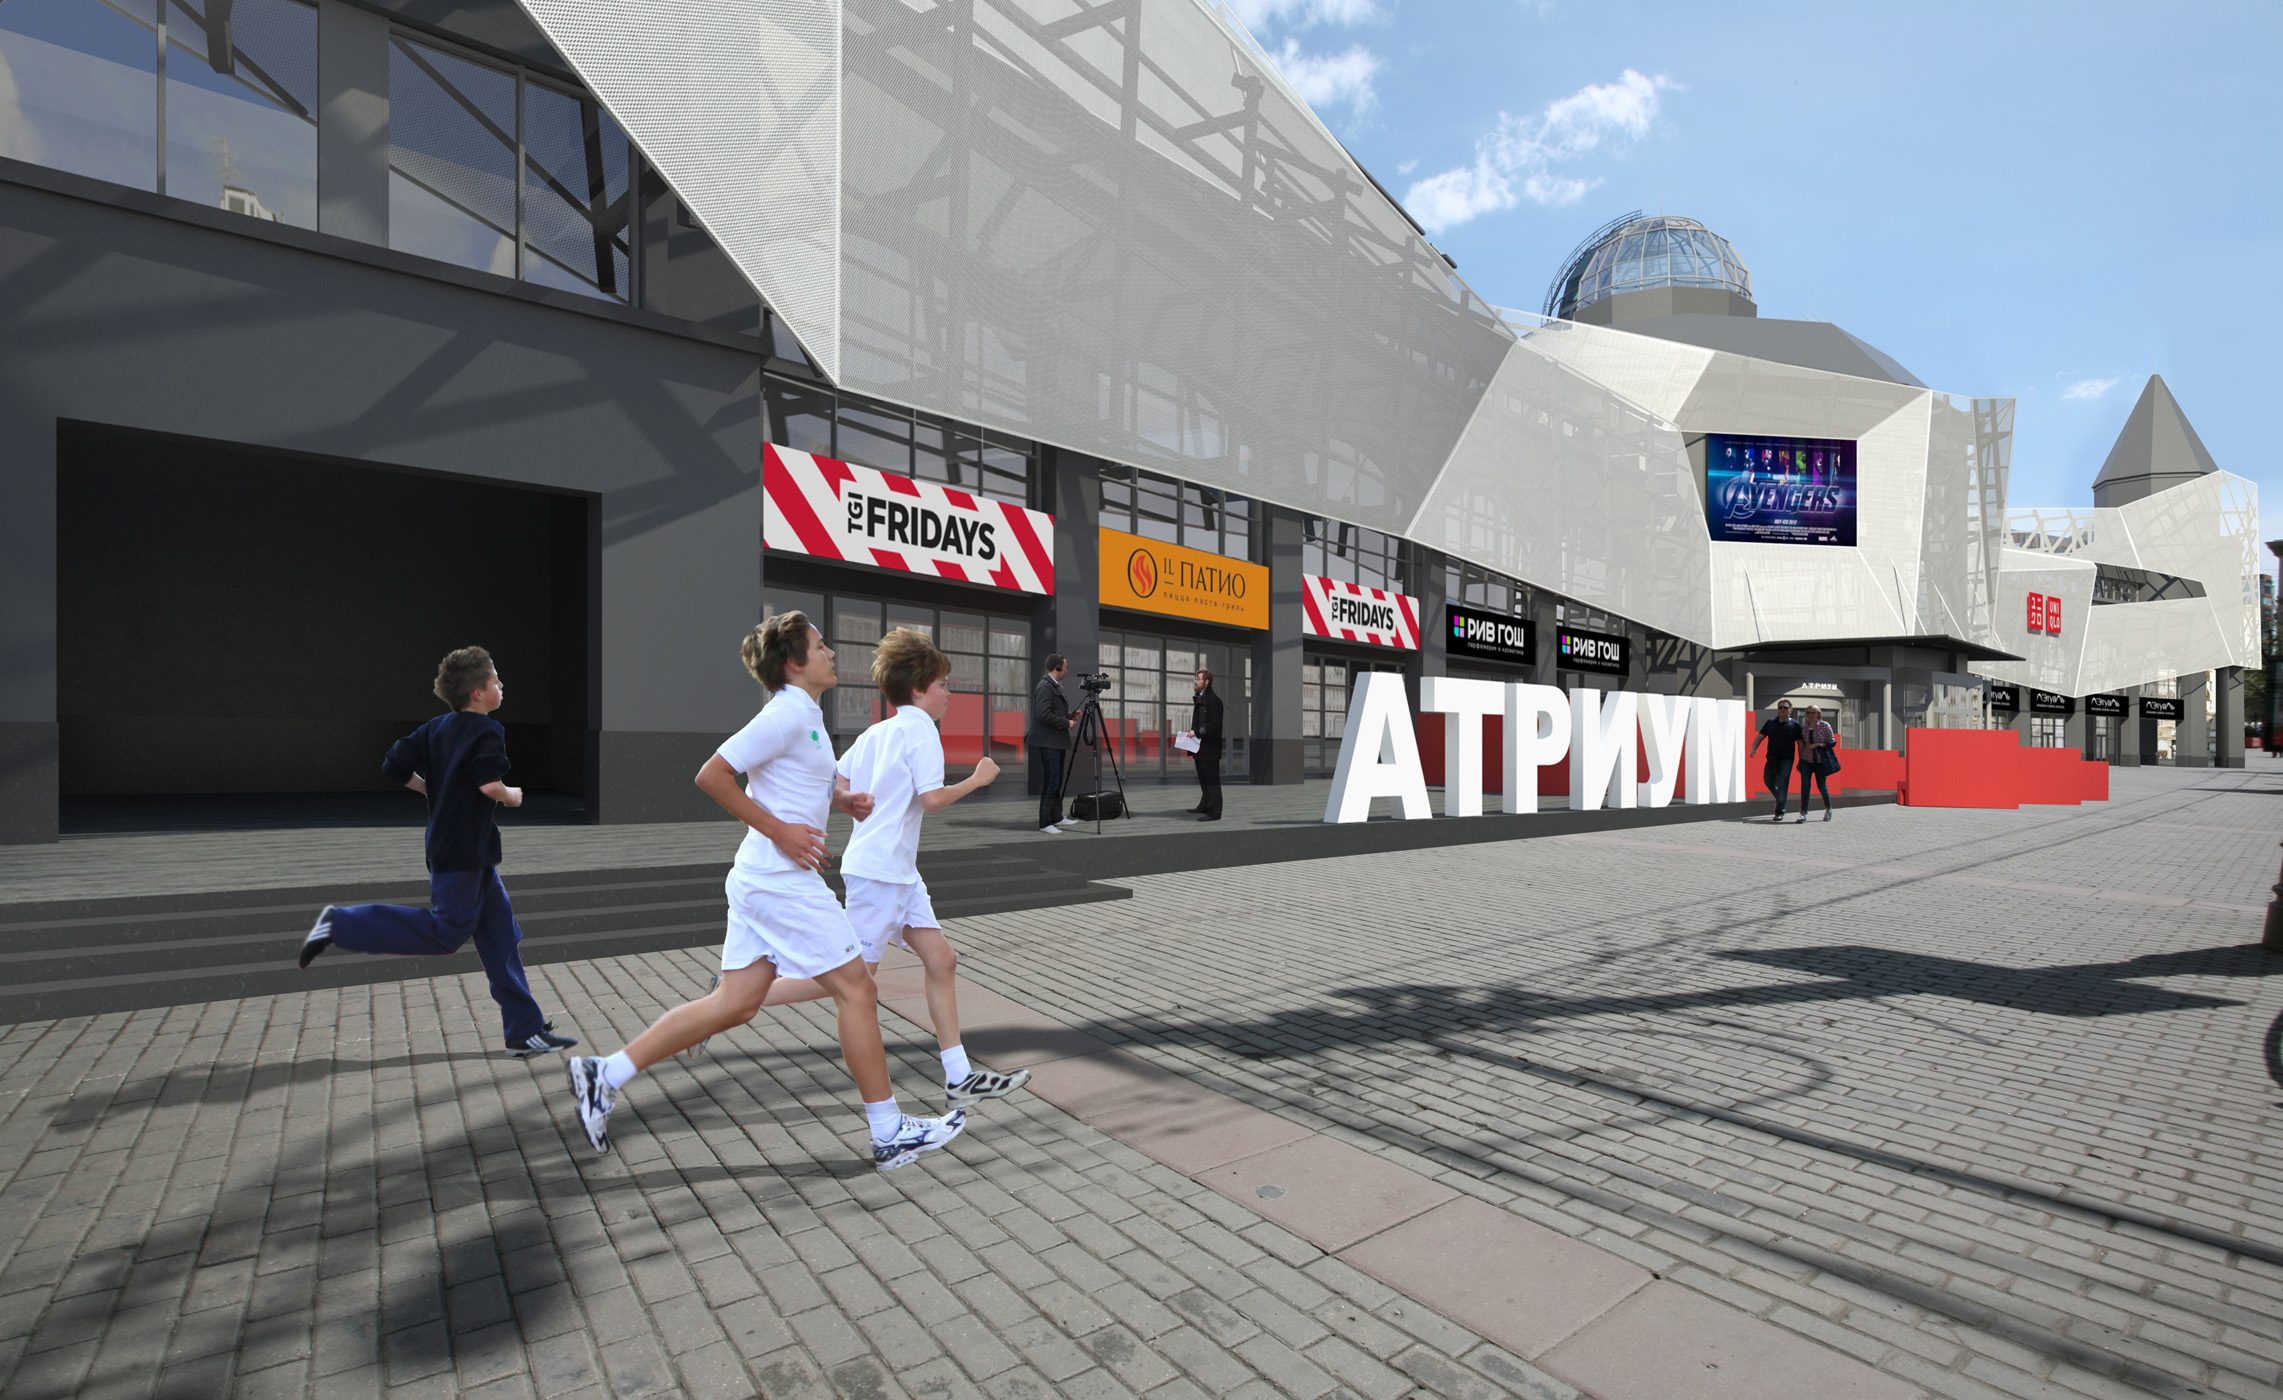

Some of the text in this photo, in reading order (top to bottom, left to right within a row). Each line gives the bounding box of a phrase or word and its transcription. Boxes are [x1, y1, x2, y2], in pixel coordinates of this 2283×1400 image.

[847, 491, 863, 534] TGI
[1722, 475, 1841, 519] AVENGERS
[867, 496, 995, 561] FRIDAYS
[1180, 561, 1246, 599] ПАТИО
[1331, 596, 1339, 621] TGI
[1340, 597, 1394, 631] FRIDAYS
[1467, 618, 1524, 648] РИВ ГОШ
[1573, 636, 1620, 661] РИВ ГОШ
[1801, 682, 1838, 690] АТРИУМ
[1324, 672, 1746, 823] АТРИУМ
